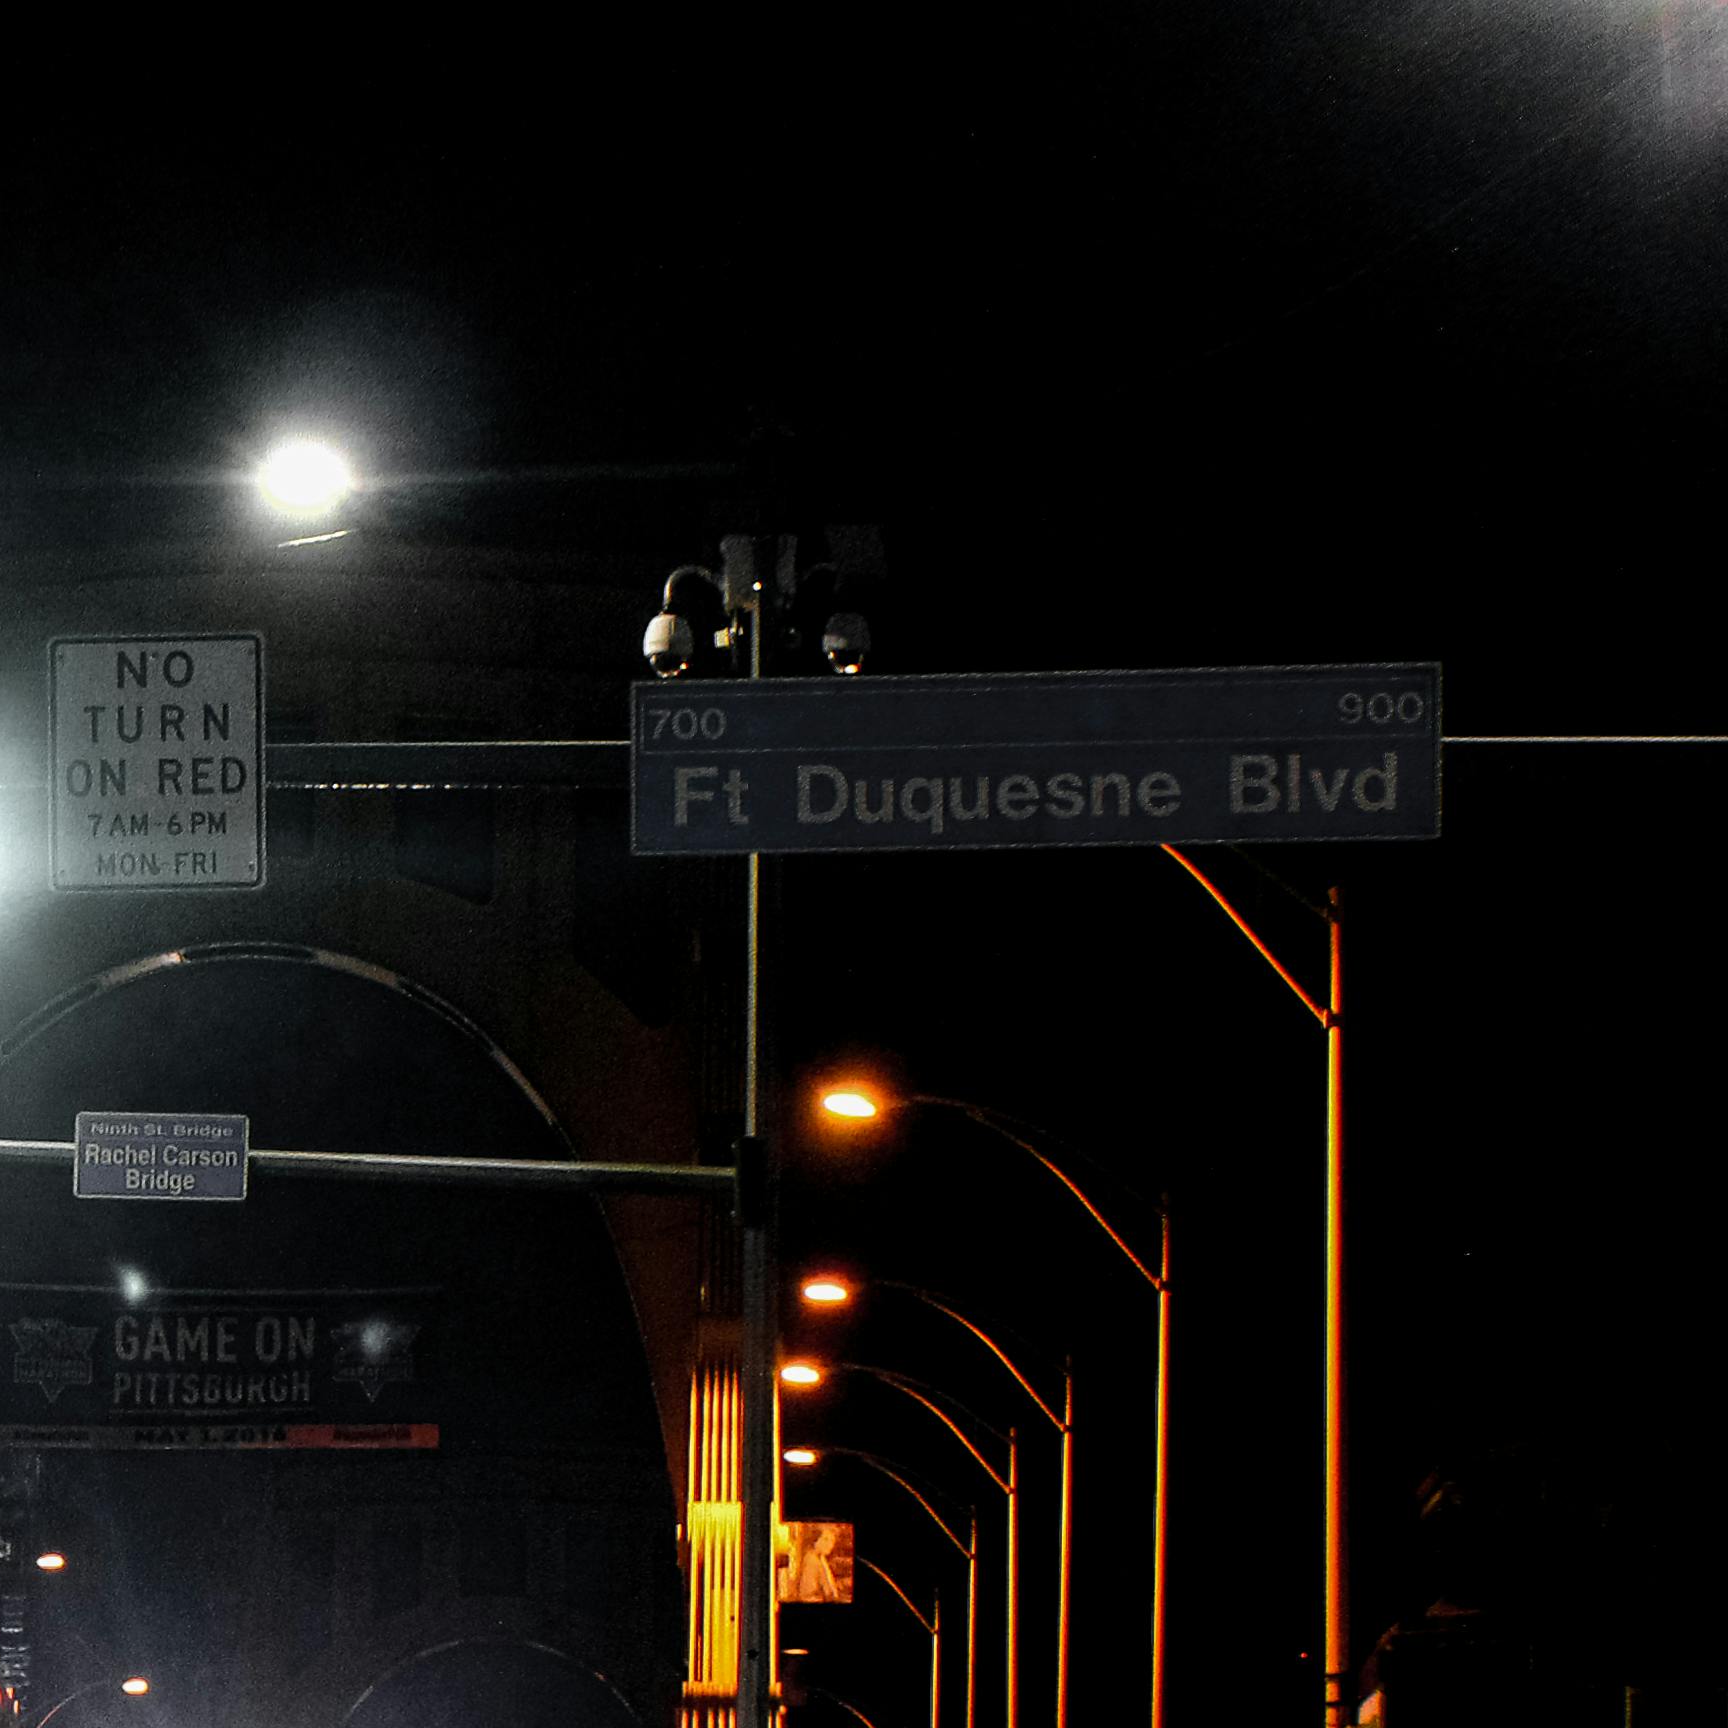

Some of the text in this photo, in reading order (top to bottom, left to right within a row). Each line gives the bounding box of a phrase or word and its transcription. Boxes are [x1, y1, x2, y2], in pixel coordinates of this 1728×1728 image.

[116, 650, 194, 688] NO
[84, 703, 230, 744] TURN
[648, 691, 1425, 741] 700 900
[66, 757, 248, 797] ON RED
[672, 751, 1398, 834] Ft Duquesne Blvd
[173, 1124, 234, 1140] Bridge
[84, 1143, 238, 1167] Rachel Carson
[125, 1168, 196, 1195] Bridge
[112, 1315, 317, 1363] GAME ON
[112, 1370, 311, 1404] PITTSBURGH
